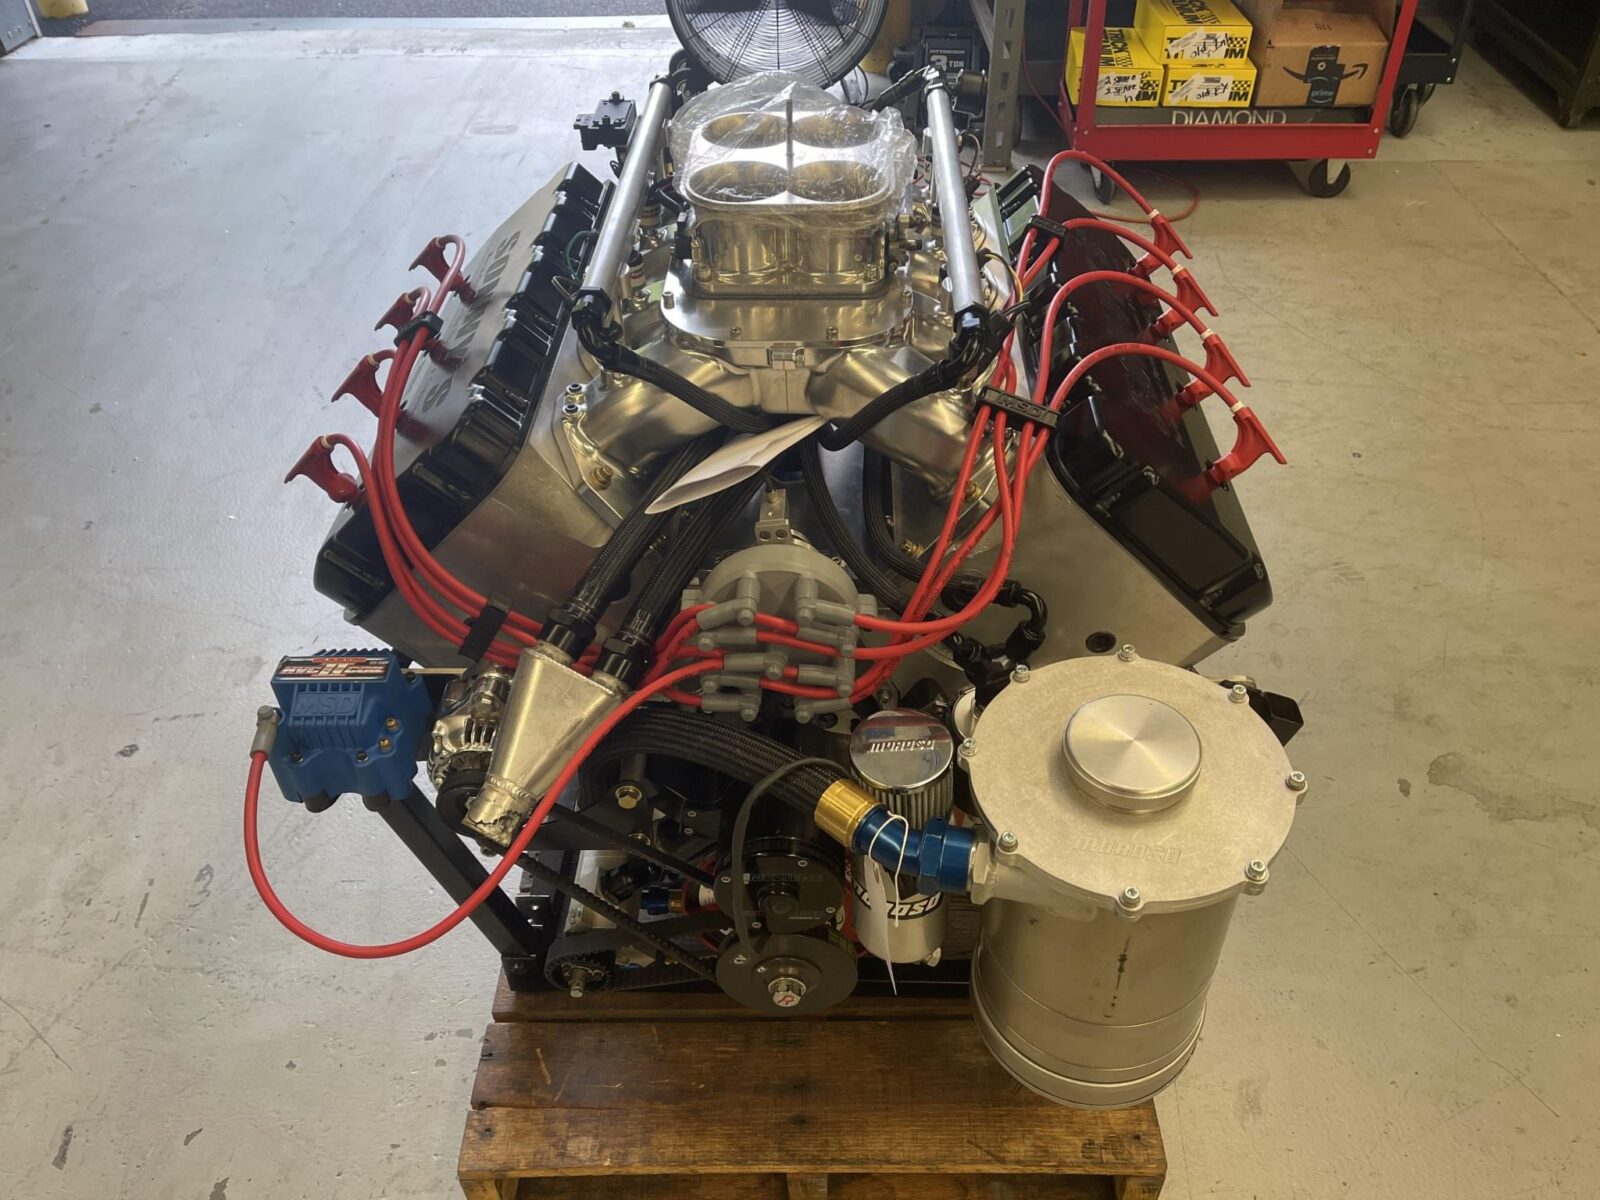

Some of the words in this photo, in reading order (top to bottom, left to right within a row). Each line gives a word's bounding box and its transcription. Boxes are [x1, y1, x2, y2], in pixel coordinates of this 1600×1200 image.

[1311, 89, 1334, 97] prime
[1172, 110, 1287, 125] DIAMOND
[294, 695, 358, 714] MSD
